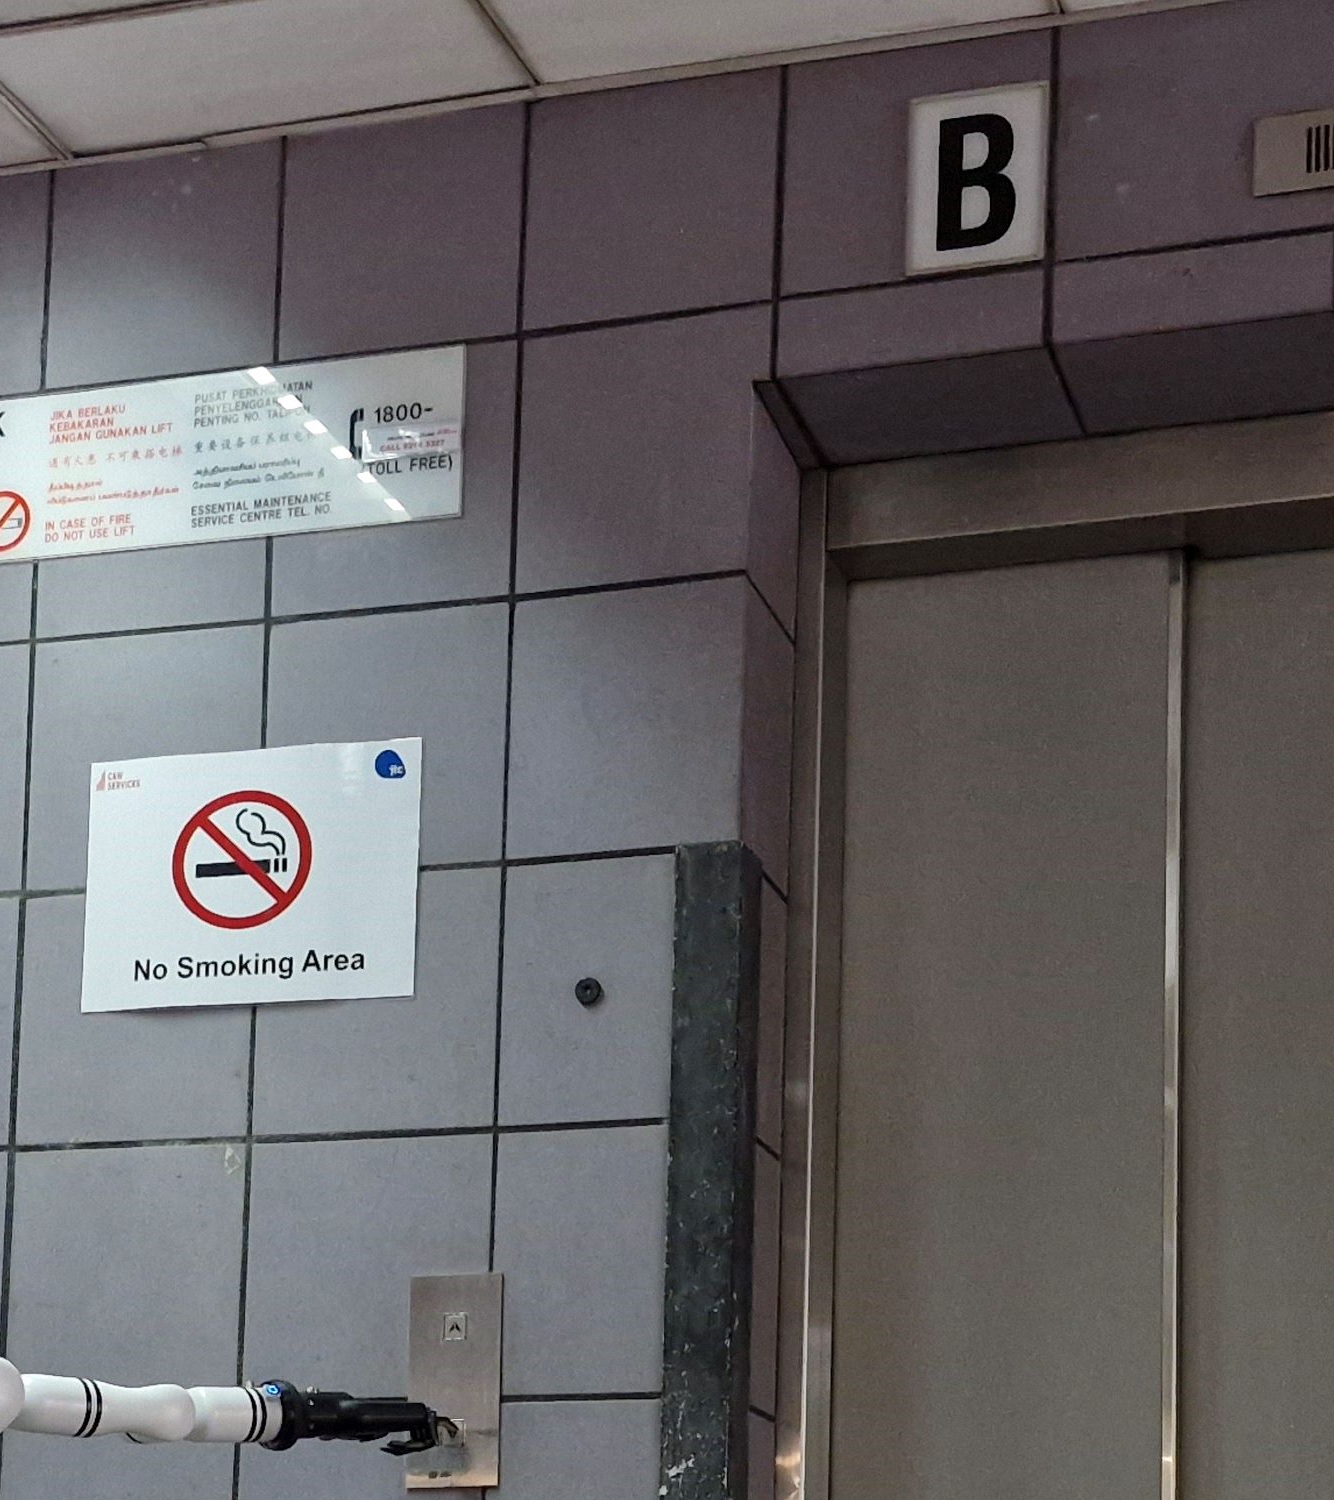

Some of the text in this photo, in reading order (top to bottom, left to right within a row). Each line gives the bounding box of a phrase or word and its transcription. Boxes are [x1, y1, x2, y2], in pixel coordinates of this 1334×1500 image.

[935, 112, 1016, 253] B
[194, 389, 227, 404] PUSAT
[50, 403, 126, 421] JIKA BERLAKU
[193, 412, 240, 429] PENTING
[373, 402, 434, 424] 1800-
[49, 417, 115, 433] KEBAKARAN
[49, 422, 174, 445] JANGAN GUNAKAN LIFT
[409, 454, 454, 473] FREE)
[190, 490, 332, 517] ESSENTIAL MAINTENANCE
[44, 513, 132, 531] IN CASE OF FIRE
[190, 513, 234, 529] SERVICE
[239, 507, 282, 523] CENTRE
[44, 525, 136, 544] DO NOT USE LIFT
[134, 949, 366, 981] No Smoking Area
